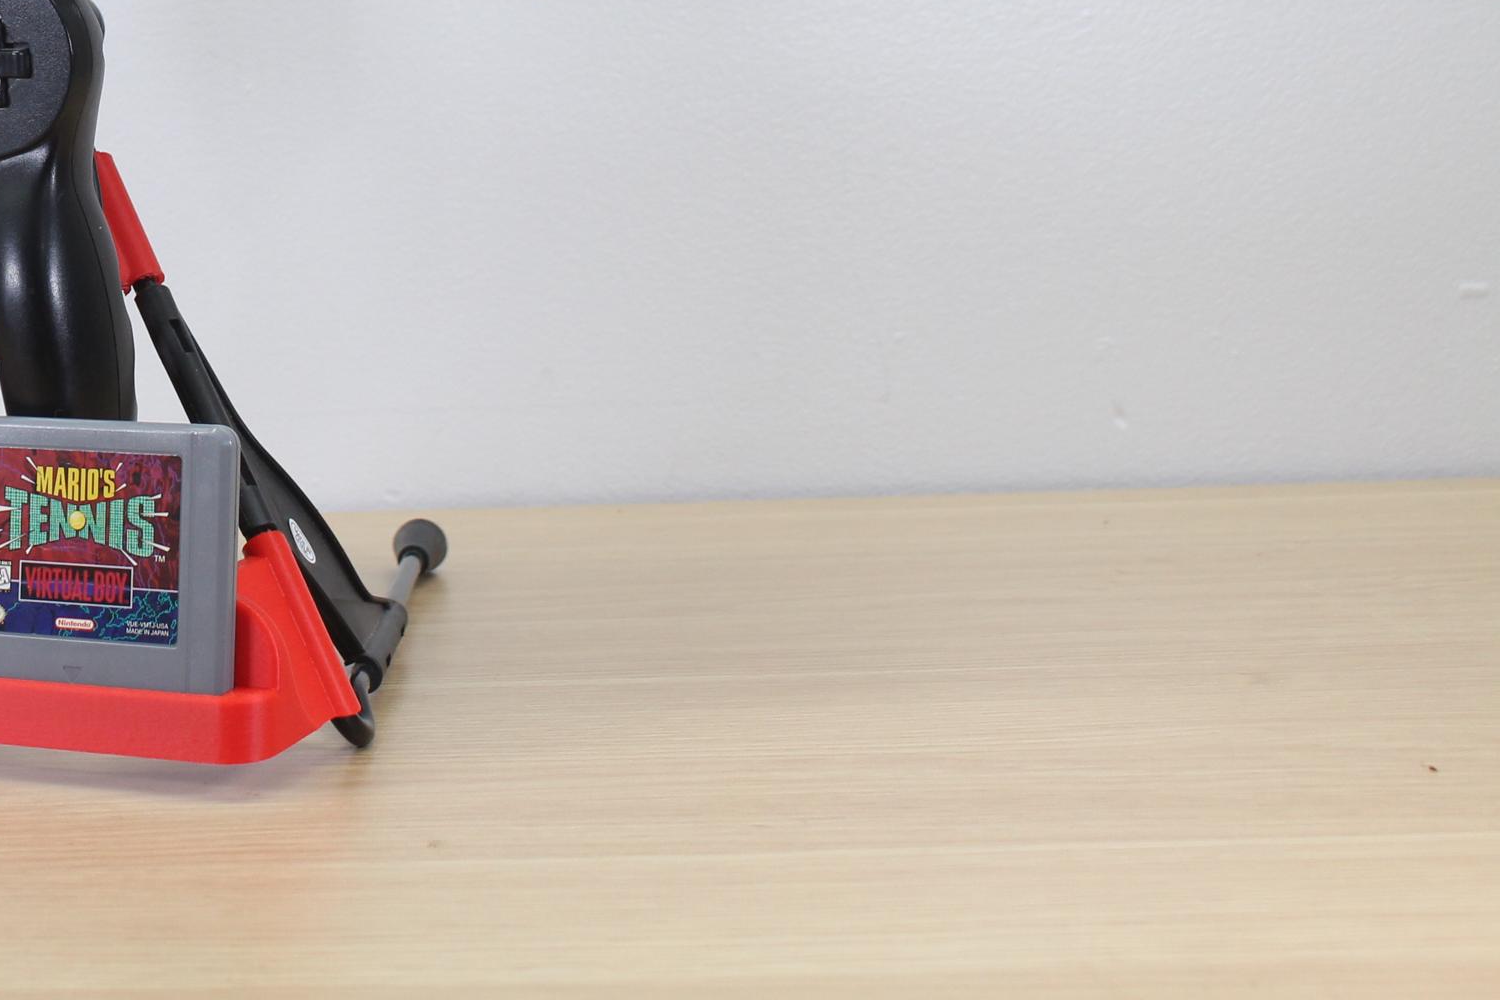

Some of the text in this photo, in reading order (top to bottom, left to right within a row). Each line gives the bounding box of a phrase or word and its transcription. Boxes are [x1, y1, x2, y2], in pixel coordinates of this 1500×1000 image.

[35, 466, 116, 501] MARIO'S
[5, 486, 154, 557] TENNIS
[25, 566, 128, 604] VIRTUAL BOY
[58, 618, 92, 628] Nintendo
